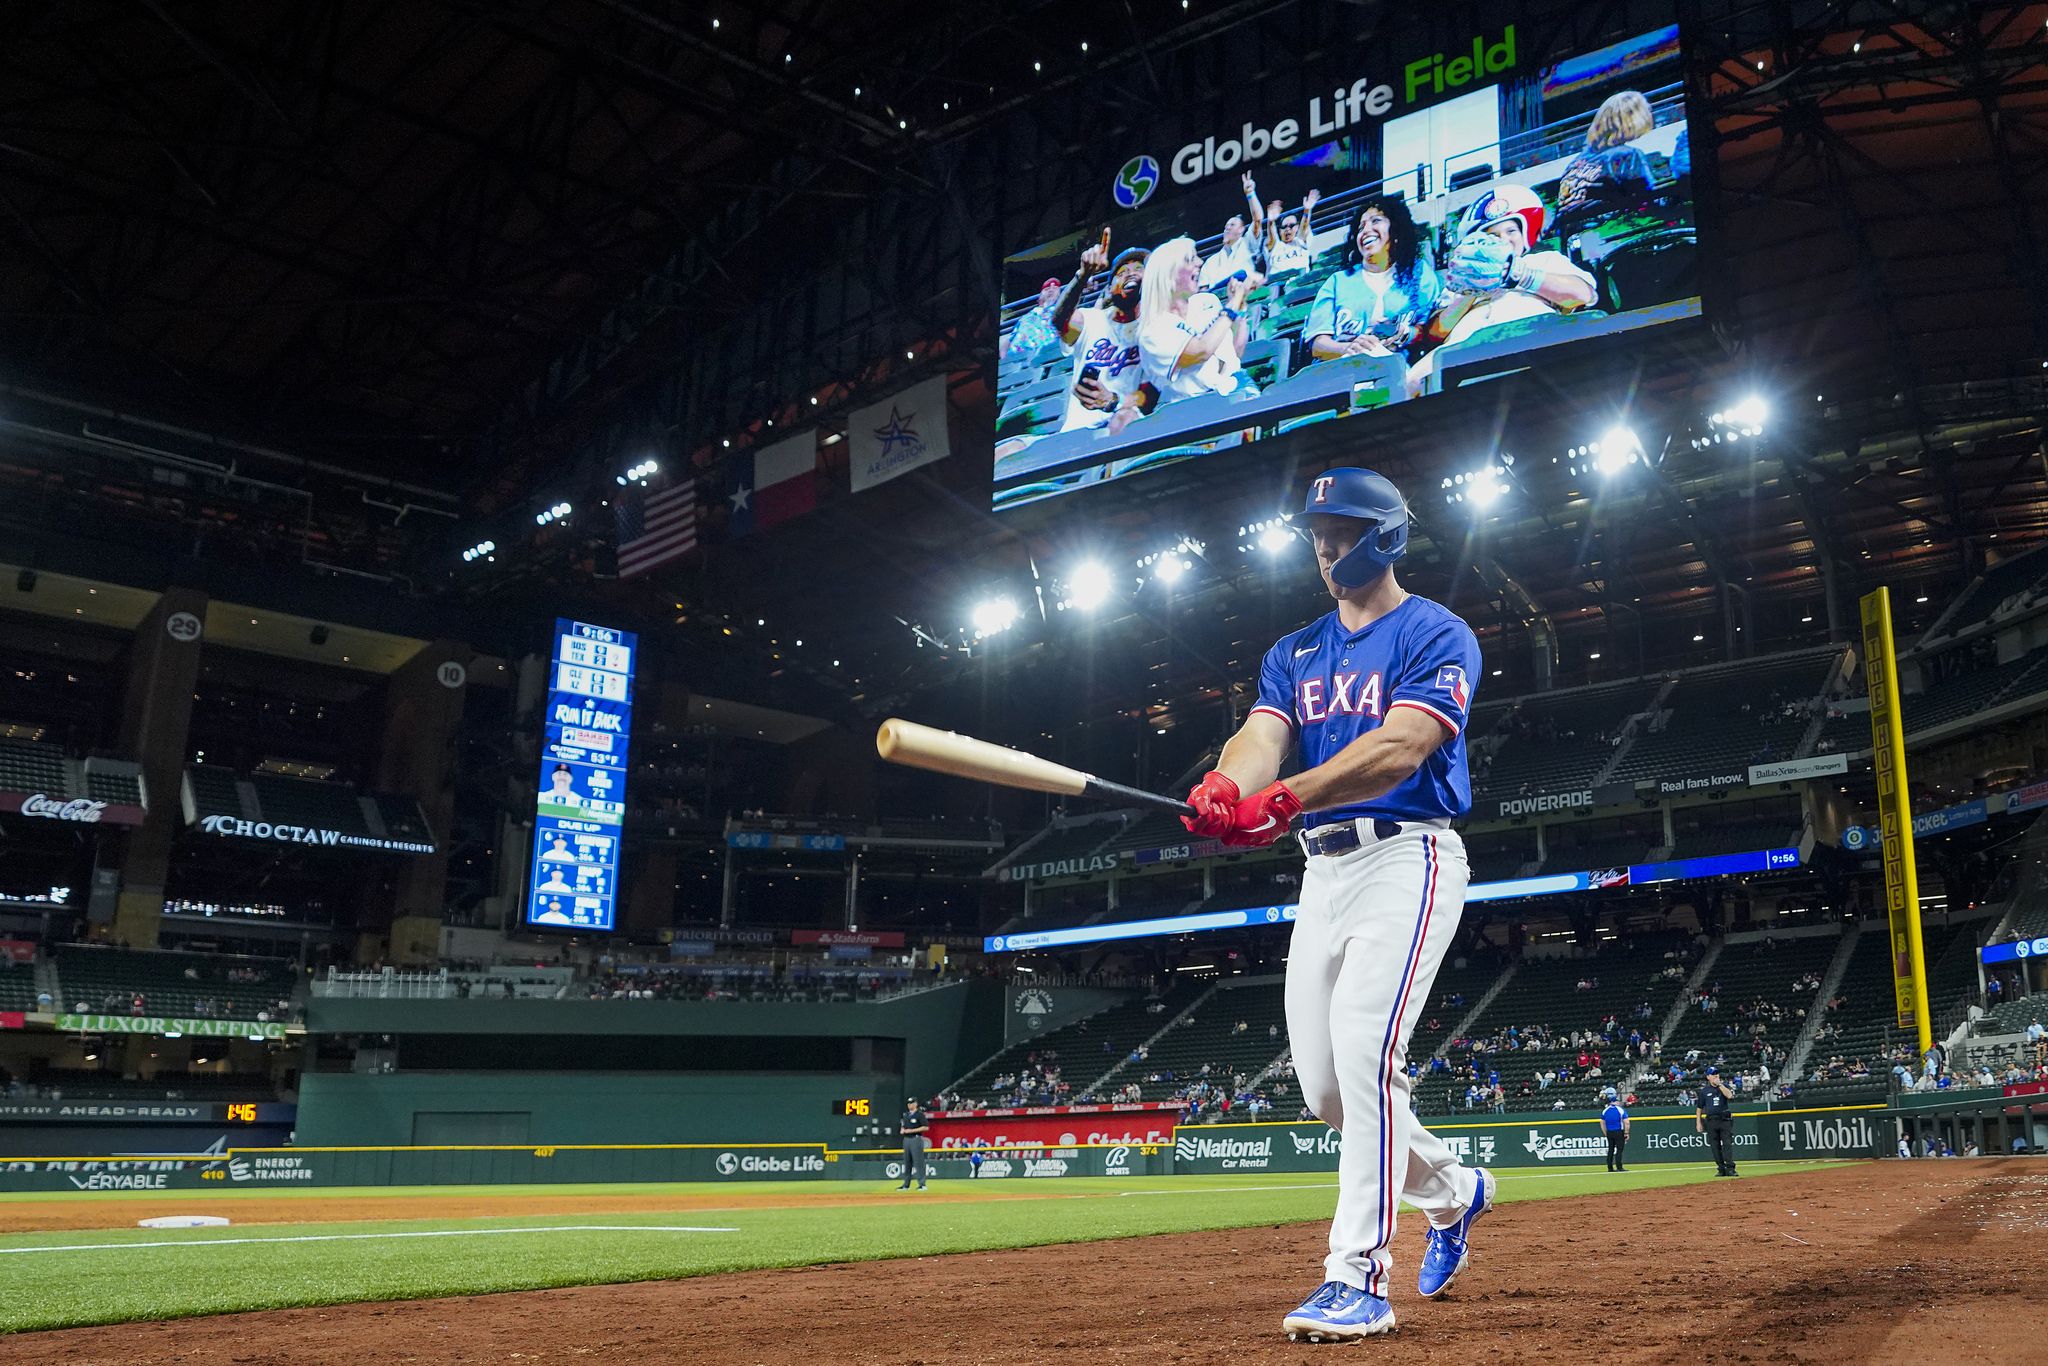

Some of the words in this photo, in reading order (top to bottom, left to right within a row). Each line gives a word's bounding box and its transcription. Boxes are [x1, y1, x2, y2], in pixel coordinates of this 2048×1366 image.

[1171, 110, 1298, 186] Globe
[1308, 77, 1394, 138] Life
[1405, 24, 1517, 104] Field
[1313, 476, 1335, 504] T
[171, 616, 198, 636] 29
[582, 626, 613, 643] 9:56
[571, 651, 585, 662] TEX
[443, 665, 460, 684] 10
[1296, 671, 1384, 725] EXA
[555, 704, 580, 726] RUN
[581, 708, 594, 727] IT
[593, 710, 622, 733] BACK
[1661, 780, 1685, 793] Real
[1686, 777, 1709, 790] fans
[1711, 772, 1743, 787] know.
[1500, 789, 1593, 817] POWERADE
[1876, 728, 1892, 794] HOT
[1885, 813, 1903, 903] ZONE
[215, 815, 340, 847] CHOCTAW
[340, 834, 383, 848] CASINOS
[392, 841, 435, 853] RESORTS
[558, 819, 583, 831] DUE
[584, 823, 602, 832] UP
[1159, 846, 1189, 861] 105.3
[1771, 853, 1795, 864] 9:56
[1011, 864, 1035, 881] UT
[1041, 853, 1118, 877] DALLAS
[675, 930, 731, 942] PRIORITY
[737, 930, 774, 943] GOLD
[81, 1014, 165, 1035] LUXOR
[175, 1017, 285, 1038] STAFFING
[227, 1103, 257, 1122] 1:46
[845, 1099, 870, 1116] 1:46
[533, 1147, 555, 1157] 407
[824, 1153, 839, 1163] 410
[1140, 1146, 1158, 1156] 374
[255, 1157, 303, 1169] ENERGY
[741, 1155, 791, 1173] Globe
[793, 1154, 824, 1172] Life
[1106, 1166, 1130, 1176] SPORTS
[1222, 1158, 1237, 1169] Car
[1239, 1157, 1268, 1168] Rental
[69, 1172, 168, 1190] VERYABLE
[201, 1169, 225, 1181] 410
[255, 1169, 312, 1180] TRANSFER
